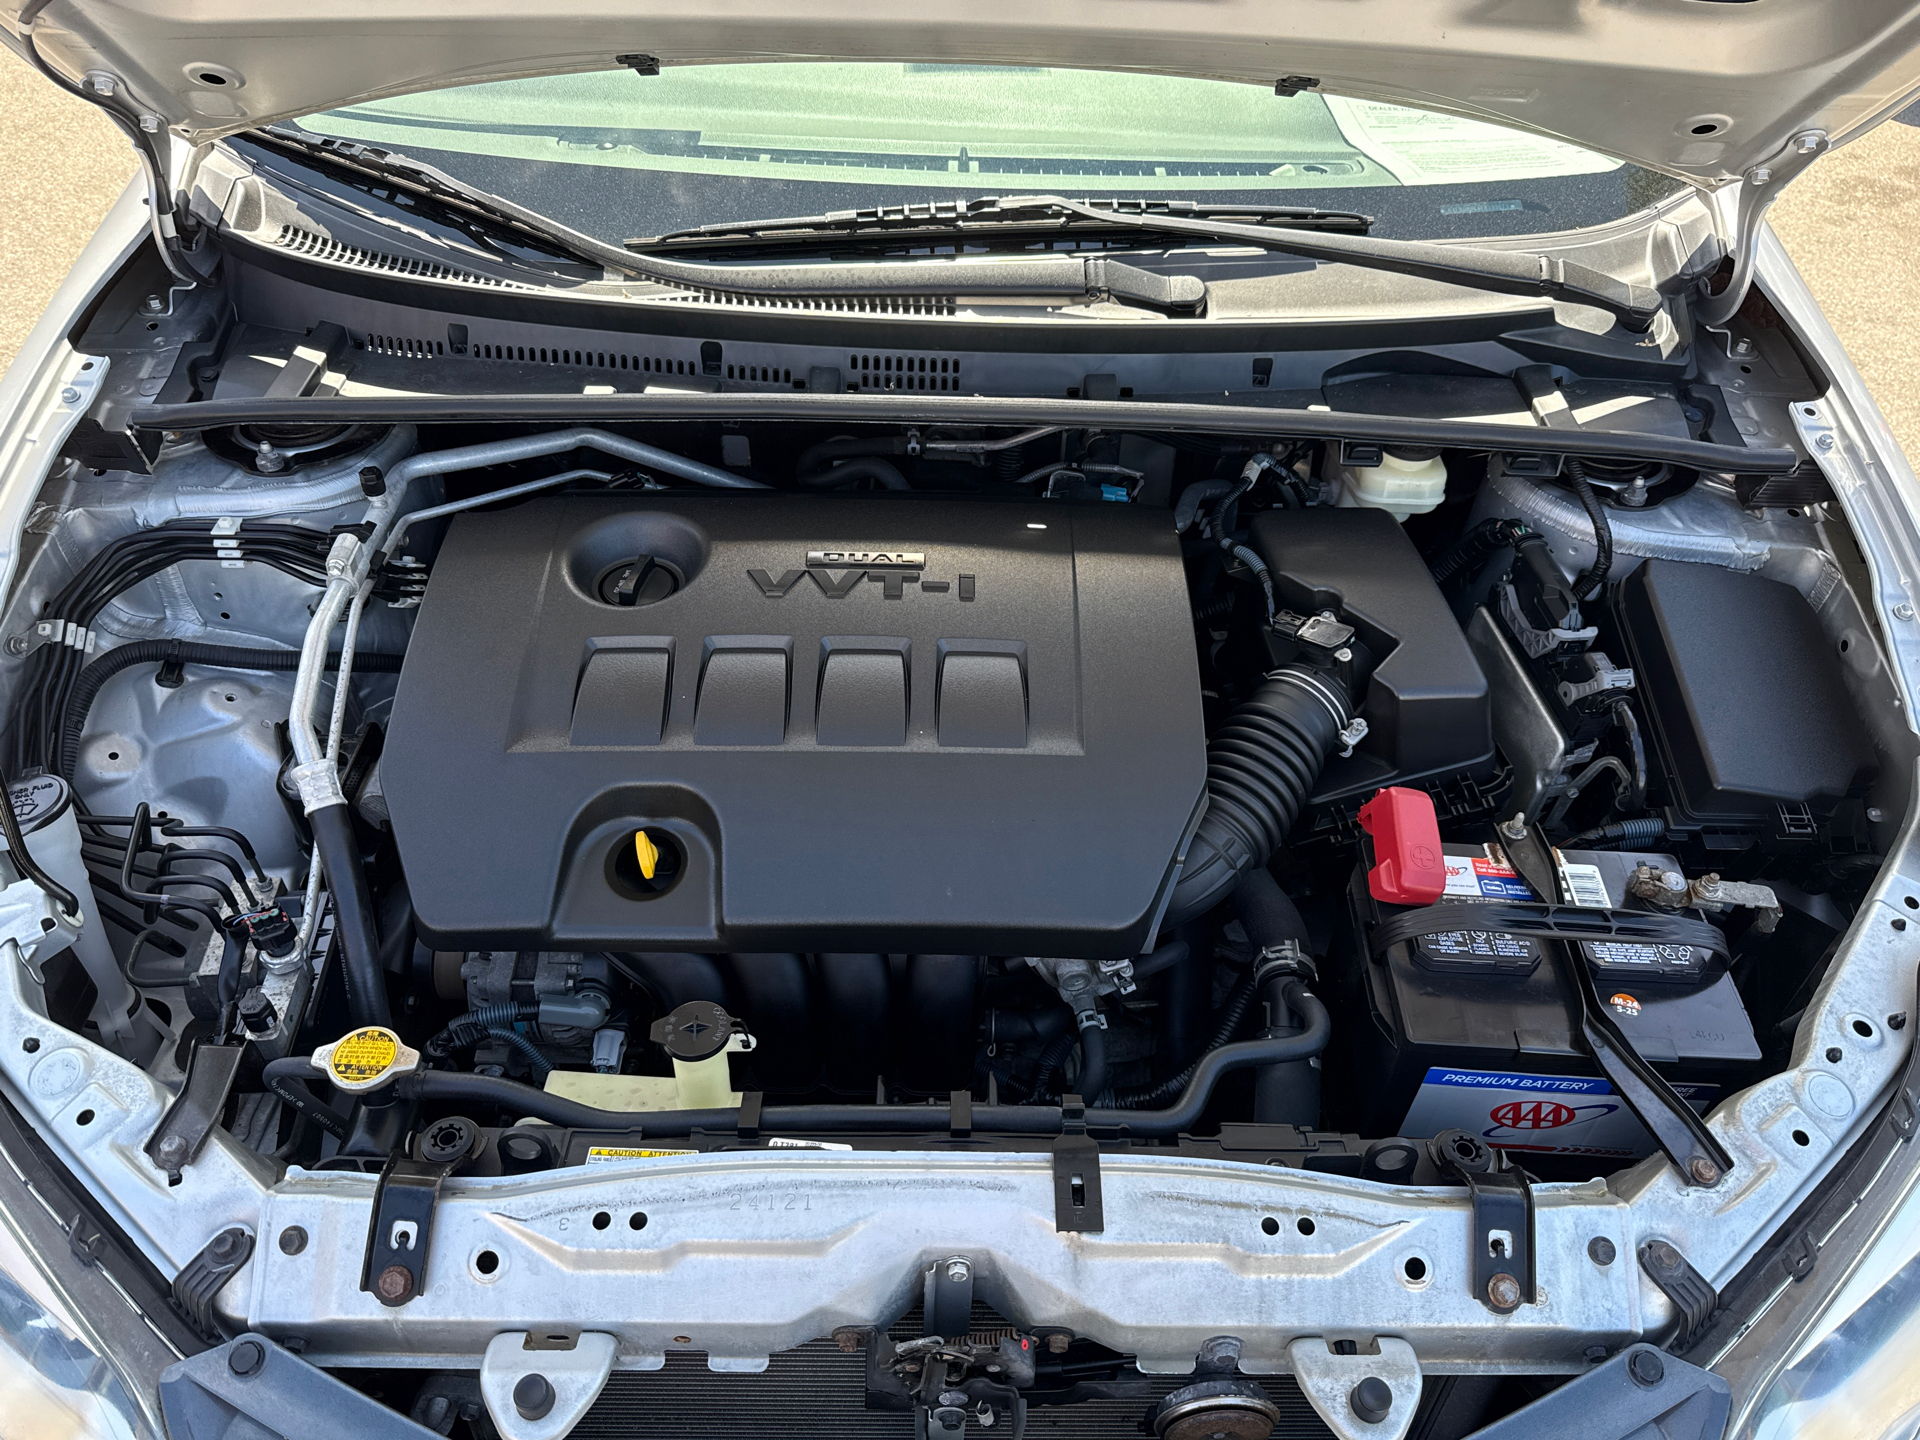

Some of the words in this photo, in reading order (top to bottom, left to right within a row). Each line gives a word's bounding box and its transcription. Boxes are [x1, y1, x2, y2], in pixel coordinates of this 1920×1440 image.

[1480, 88, 1527, 96] TOYOTA
[823, 552, 919, 563] DUAL
[32, 782, 54, 791] FLUID
[14, 791, 35, 800] ONLY
[1614, 997, 1639, 1009] M-24
[1442, 1074, 1519, 1086] PREMIUM
[1519, 1079, 1595, 1091] BATTERY
[1497, 1101, 1566, 1129] AAA
[730, 1193, 812, 1211] 24121
